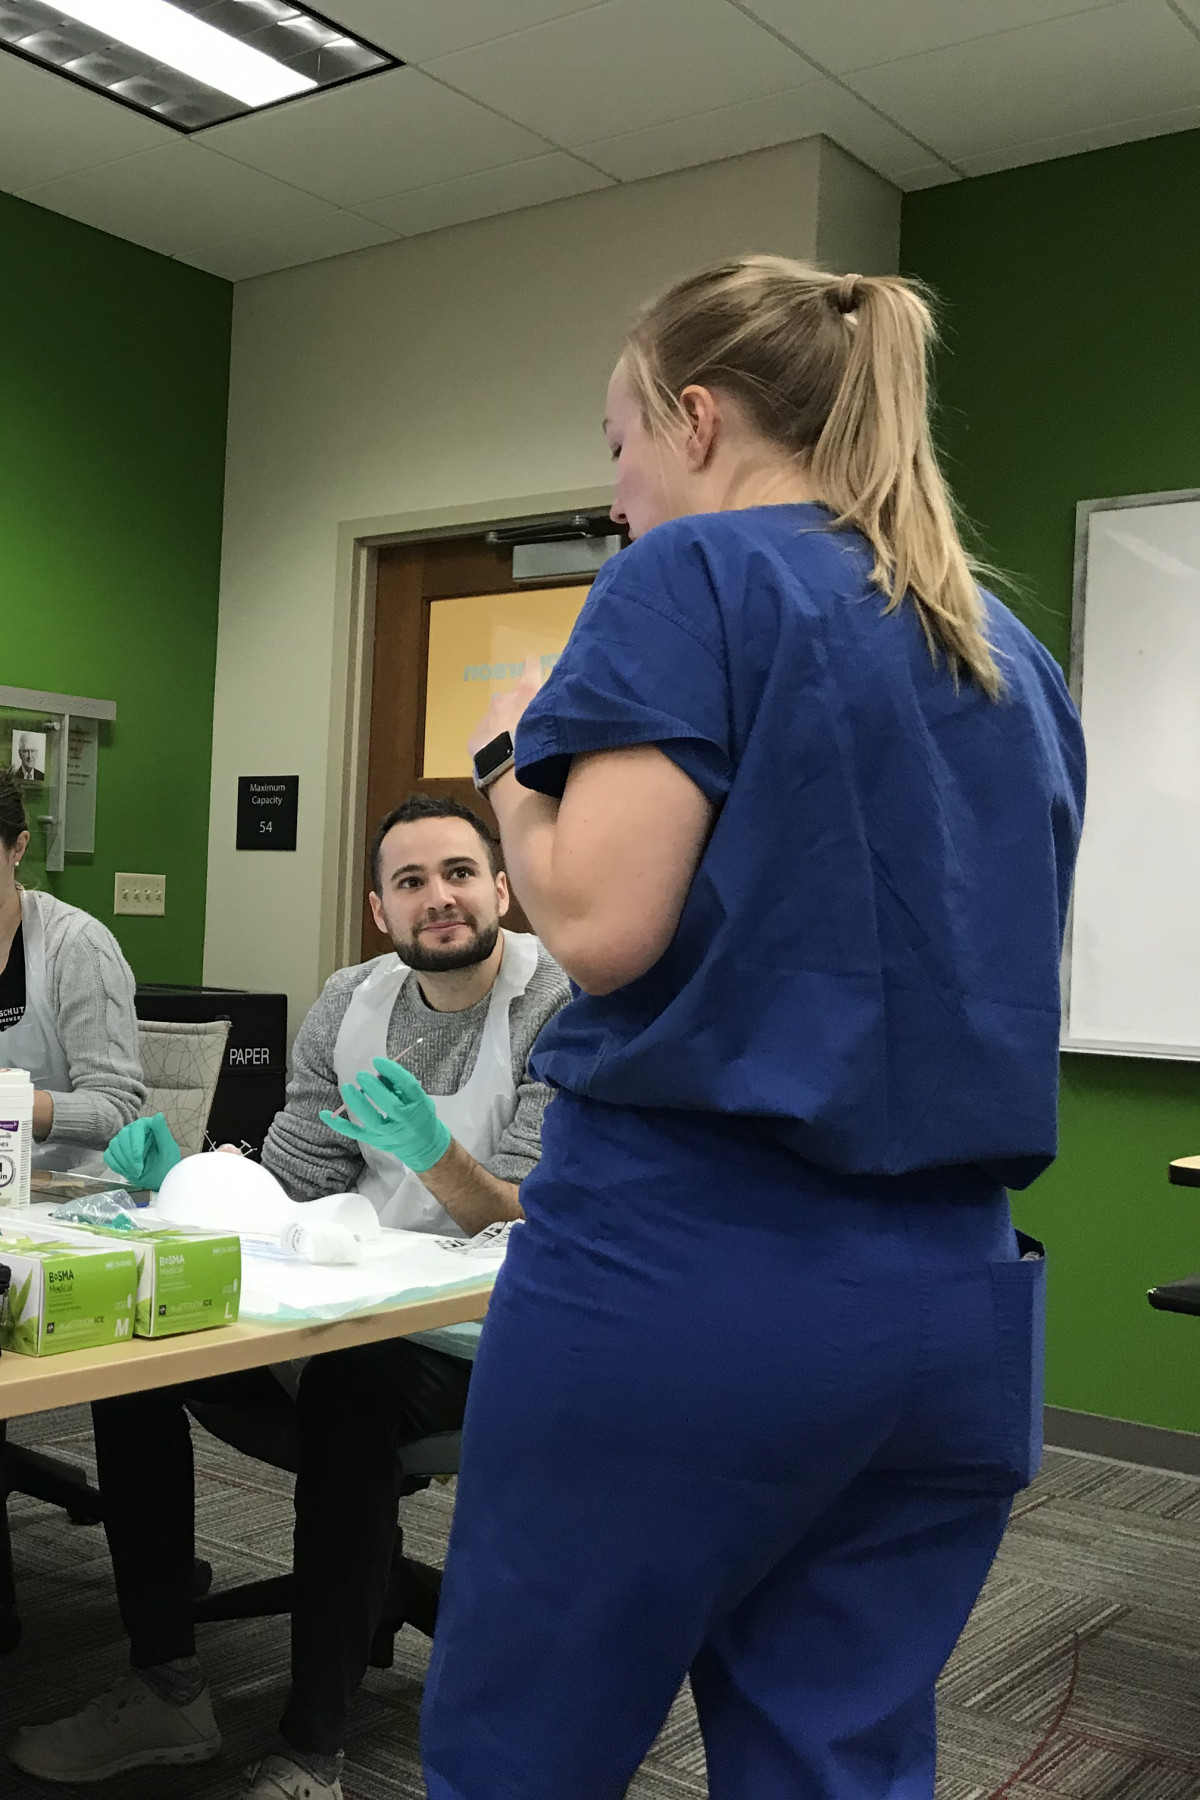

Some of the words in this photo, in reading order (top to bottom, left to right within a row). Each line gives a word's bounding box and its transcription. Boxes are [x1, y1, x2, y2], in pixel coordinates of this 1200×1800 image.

[250, 783, 286, 792] Maximum
[251, 795, 283, 807] Capacity
[259, 820, 273, 833] 54
[229, 1047, 270, 1066] PAPER
[224, 1302, 233, 1319] L
[114, 1318, 129, 1337] M
